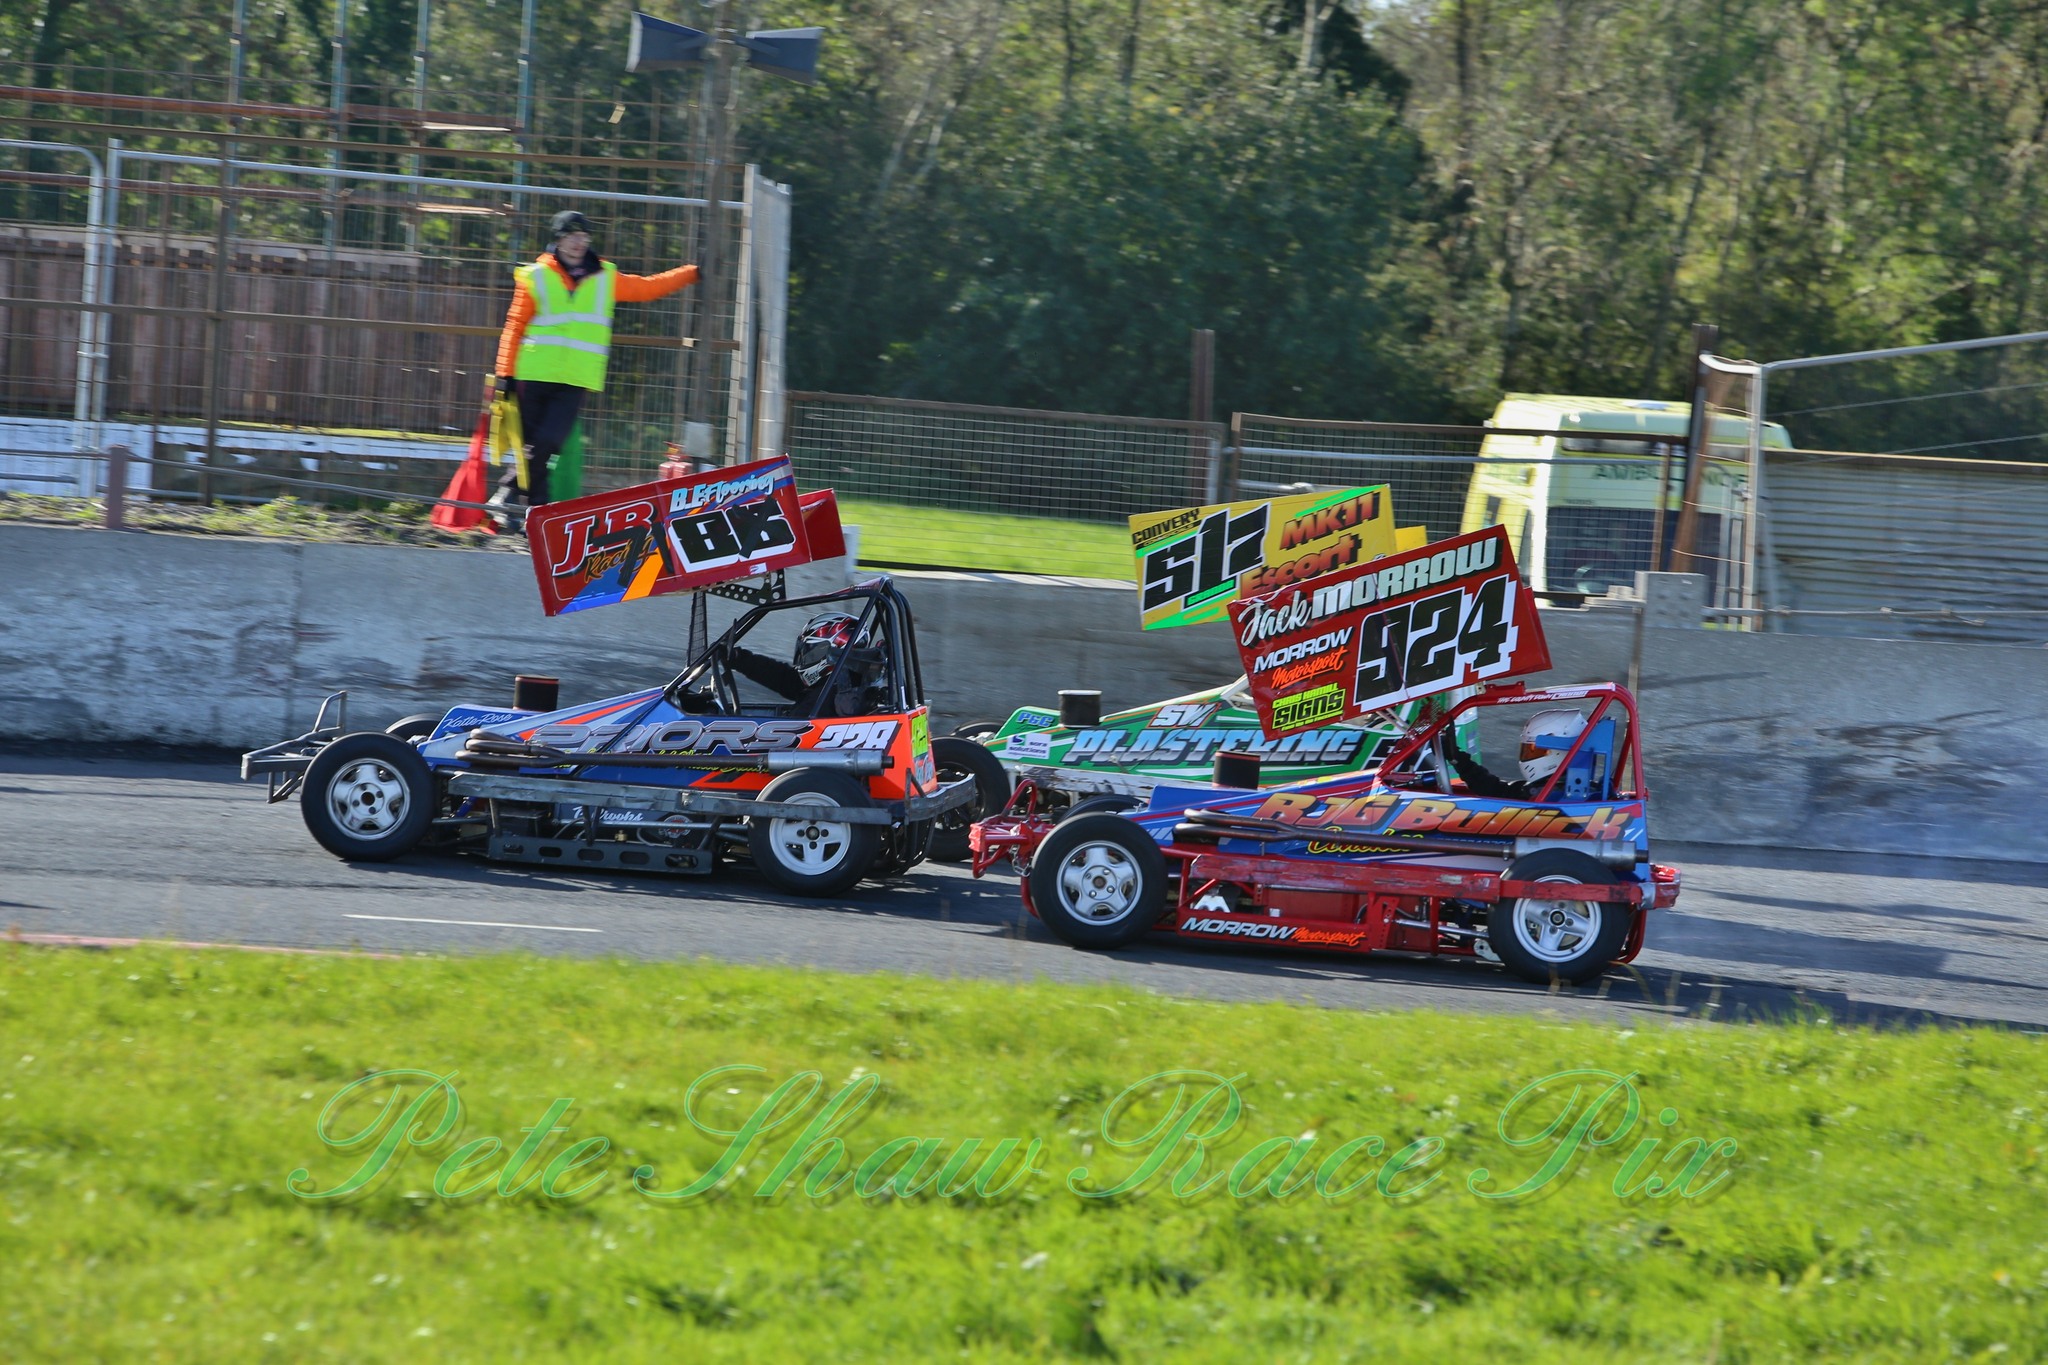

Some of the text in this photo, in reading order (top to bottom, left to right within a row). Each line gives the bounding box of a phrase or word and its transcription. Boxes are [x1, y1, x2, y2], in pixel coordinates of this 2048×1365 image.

[1141, 501, 1270, 614] 517
[1241, 533, 1362, 599] Escort
[1238, 537, 1499, 647] Jack MORROW
[1253, 626, 1353, 674] MORROW
[1353, 574, 1519, 713] 924
[1271, 646, 1347, 690] Motorsport
[1061, 729, 1363, 765] PLASTERING
[1253, 793, 1396, 831] RJG
[1181, 917, 1367, 947] MORROW Motorsport
